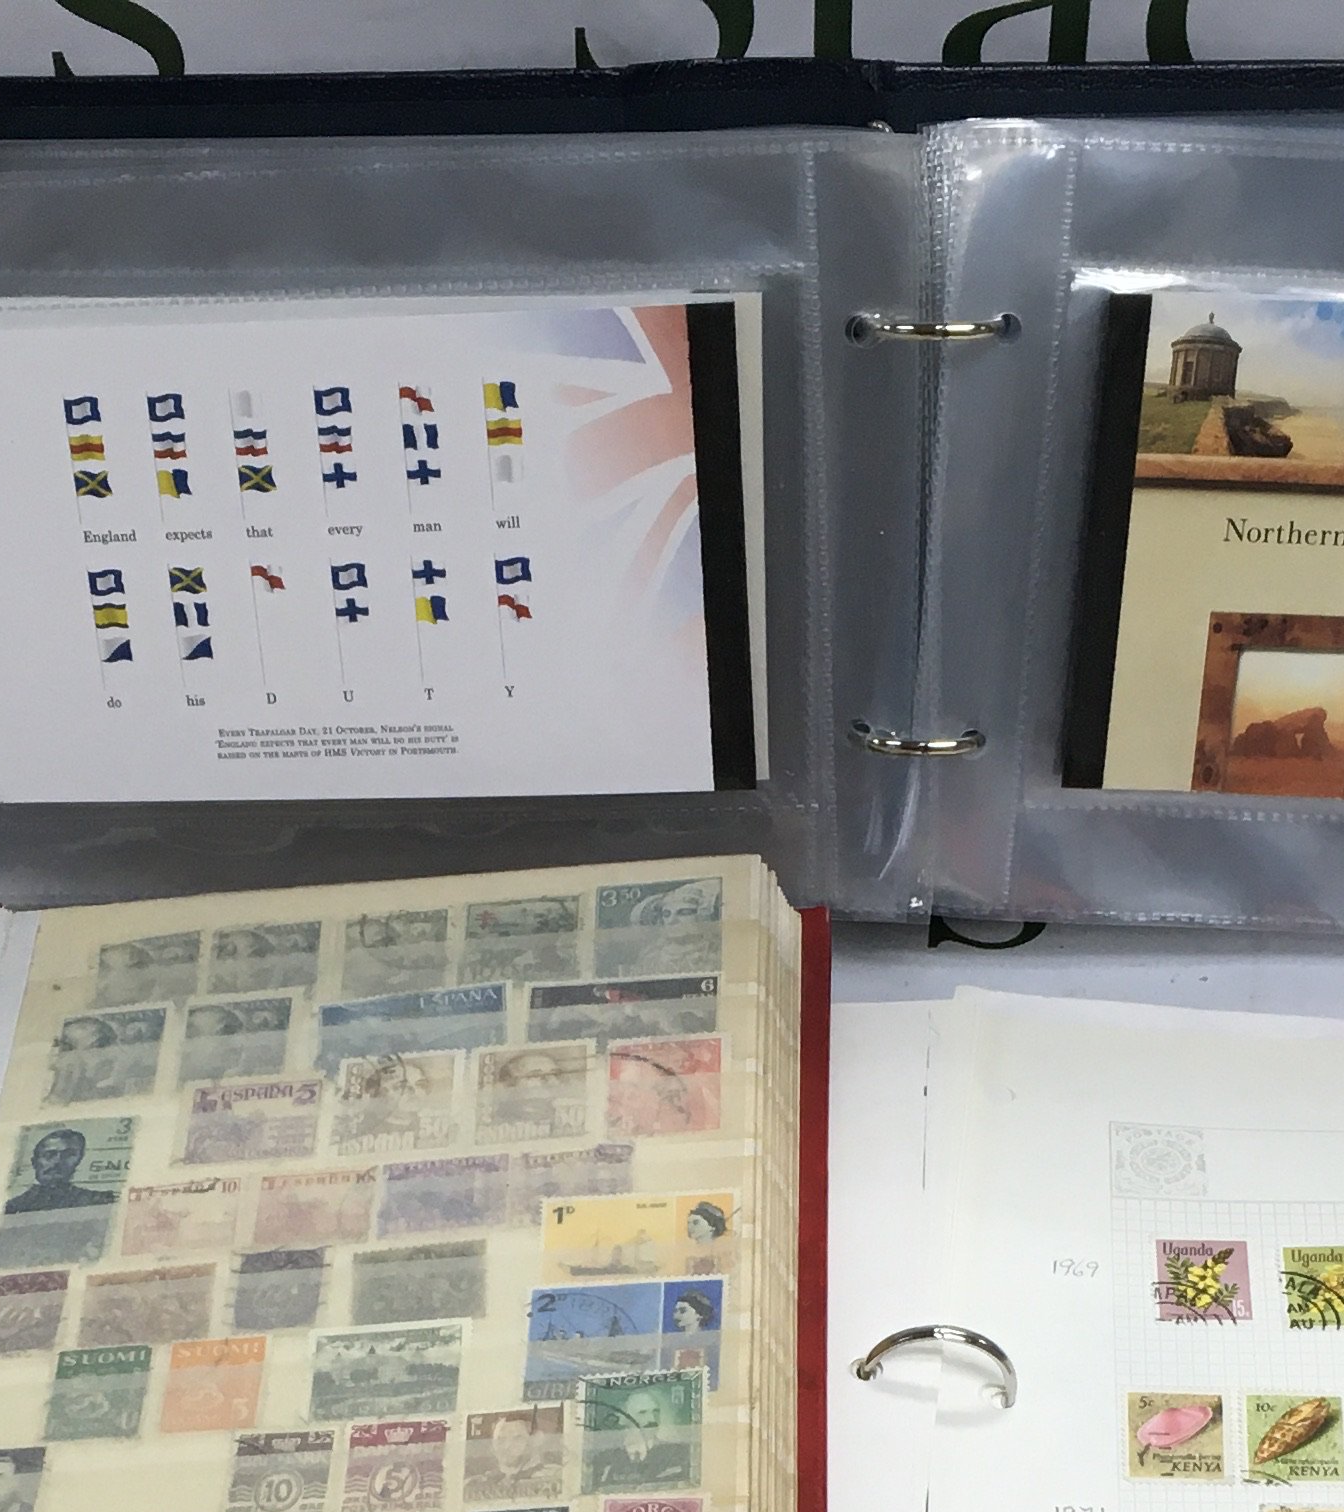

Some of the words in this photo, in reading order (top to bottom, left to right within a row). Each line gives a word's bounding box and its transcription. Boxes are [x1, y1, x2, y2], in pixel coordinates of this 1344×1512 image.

[83, 529, 137, 545] England
[165, 528, 213, 543] expects
[246, 525, 273, 539] that
[327, 523, 363, 538] every
[413, 520, 442, 533] man
[495, 516, 520, 530] will
[107, 697, 122, 709] do
[186, 694, 205, 707] his
[266, 692, 277, 705] D
[342, 690, 354, 702] U
[424, 688, 434, 700] T
[504, 685, 515, 698] Y
[322, 726, 333, 735] 21
[1162, 1242, 1214, 1259] Uganda
[1052, 1259, 1100, 1279] 1969
[61, 1349, 147, 1368] SUOMI
[1171, 1460, 1222, 1474] KENYA
[1289, 1464, 1340, 1478] KENYA
[263, 1479, 292, 1503] 10
